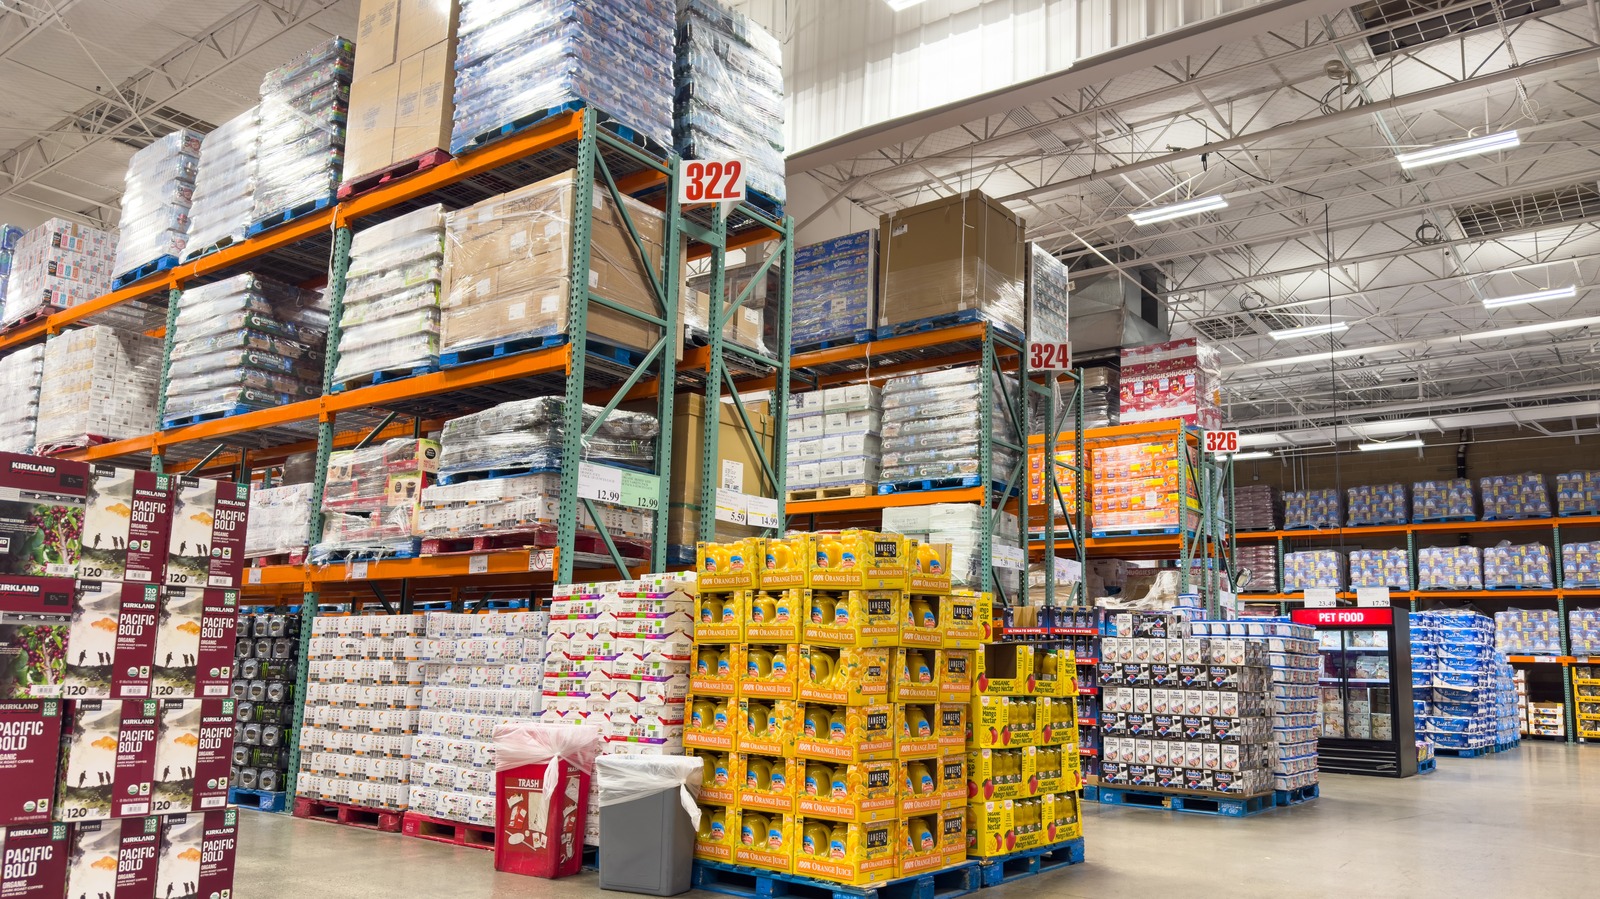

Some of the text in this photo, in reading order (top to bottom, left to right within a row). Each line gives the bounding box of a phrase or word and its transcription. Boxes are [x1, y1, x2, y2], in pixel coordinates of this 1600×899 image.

[685, 160, 742, 200] 322
[1031, 343, 1069, 368] 324
[1169, 369, 1196, 377] HUGGIES
[1207, 432, 1237, 451] 326
[12, 462, 55, 473] KIRKLAND
[135, 489, 167, 498] KIRKLAND
[597, 489, 619, 501] 12.99
[133, 500, 166, 513] PACIFIC
[217, 499, 246, 507] KIRKLAND
[638, 497, 658, 508] 12.99
[132, 511, 155, 523] BOLD
[215, 509, 246, 522] PACIFIC
[731, 511, 745, 522] 5.59
[761, 516, 777, 525] 14.99
[214, 519, 236, 531] BOLD
[875, 543, 896, 555] LANGERS
[83, 568, 102, 577] 120
[846, 574, 860, 582] JUICE
[170, 574, 187, 583] 120
[735, 576, 750, 584] JUICE
[123, 602, 155, 610] KIRKLAND
[869, 601, 890, 612] LANGERS
[954, 606, 972, 617] LANGERS
[120, 614, 155, 625] PACIFIC
[202, 617, 234, 628] PACIFIC
[1319, 612, 1364, 622] PET FOOD
[119, 625, 143, 636] BOLD
[202, 628, 224, 638] BOLD
[780, 629, 793, 637] JUICE
[818, 631, 839, 639] ORANGE
[840, 632, 854, 640] JUICE
[949, 660, 965, 669] LANGERS
[67, 685, 87, 695] 120
[155, 686, 173, 695] 120
[755, 684, 776, 692] ORANGE
[777, 685, 791, 693] JUICE
[988, 685, 1001, 693] Mango
[868, 715, 886, 727] LANGERS
[944, 714, 960, 723] LANGERS
[120, 730, 154, 741] PACIFIC
[200, 727, 232, 738] PACIFIC
[0, 736, 27, 751] OLD
[199, 738, 221, 749] BOLD
[697, 735, 717, 743] ORANGE
[717, 736, 731, 745] JUICE
[119, 742, 143, 753] BOLD
[812, 744, 834, 754] ORANGE
[835, 747, 851, 757] JUICE
[518, 778, 539, 788] TRASH
[869, 772, 888, 785] LANGERS
[993, 791, 1005, 799] Mango
[152, 801, 171, 810] 120
[754, 796, 775, 805] ORANGE
[775, 797, 790, 806] JUICE
[67, 808, 87, 818] 120
[814, 803, 836, 812] ORANGE
[837, 805, 853, 815] JUICE
[10, 828, 48, 837] KIRKLAND
[123, 835, 155, 843] KIRKLAND
[868, 832, 886, 845] LANGERS
[203, 839, 234, 851] PACIFIC
[5, 846, 53, 864] PACIFIC
[120, 847, 155, 860] PACIFIC
[202, 850, 224, 863] BOLD
[750, 853, 772, 863] ORANGE
[772, 856, 787, 865] JUICE
[4, 862, 37, 879] BOLD
[119, 859, 143, 872] BOLD
[812, 863, 835, 873] ORANGE
[836, 866, 852, 876] JUICE
